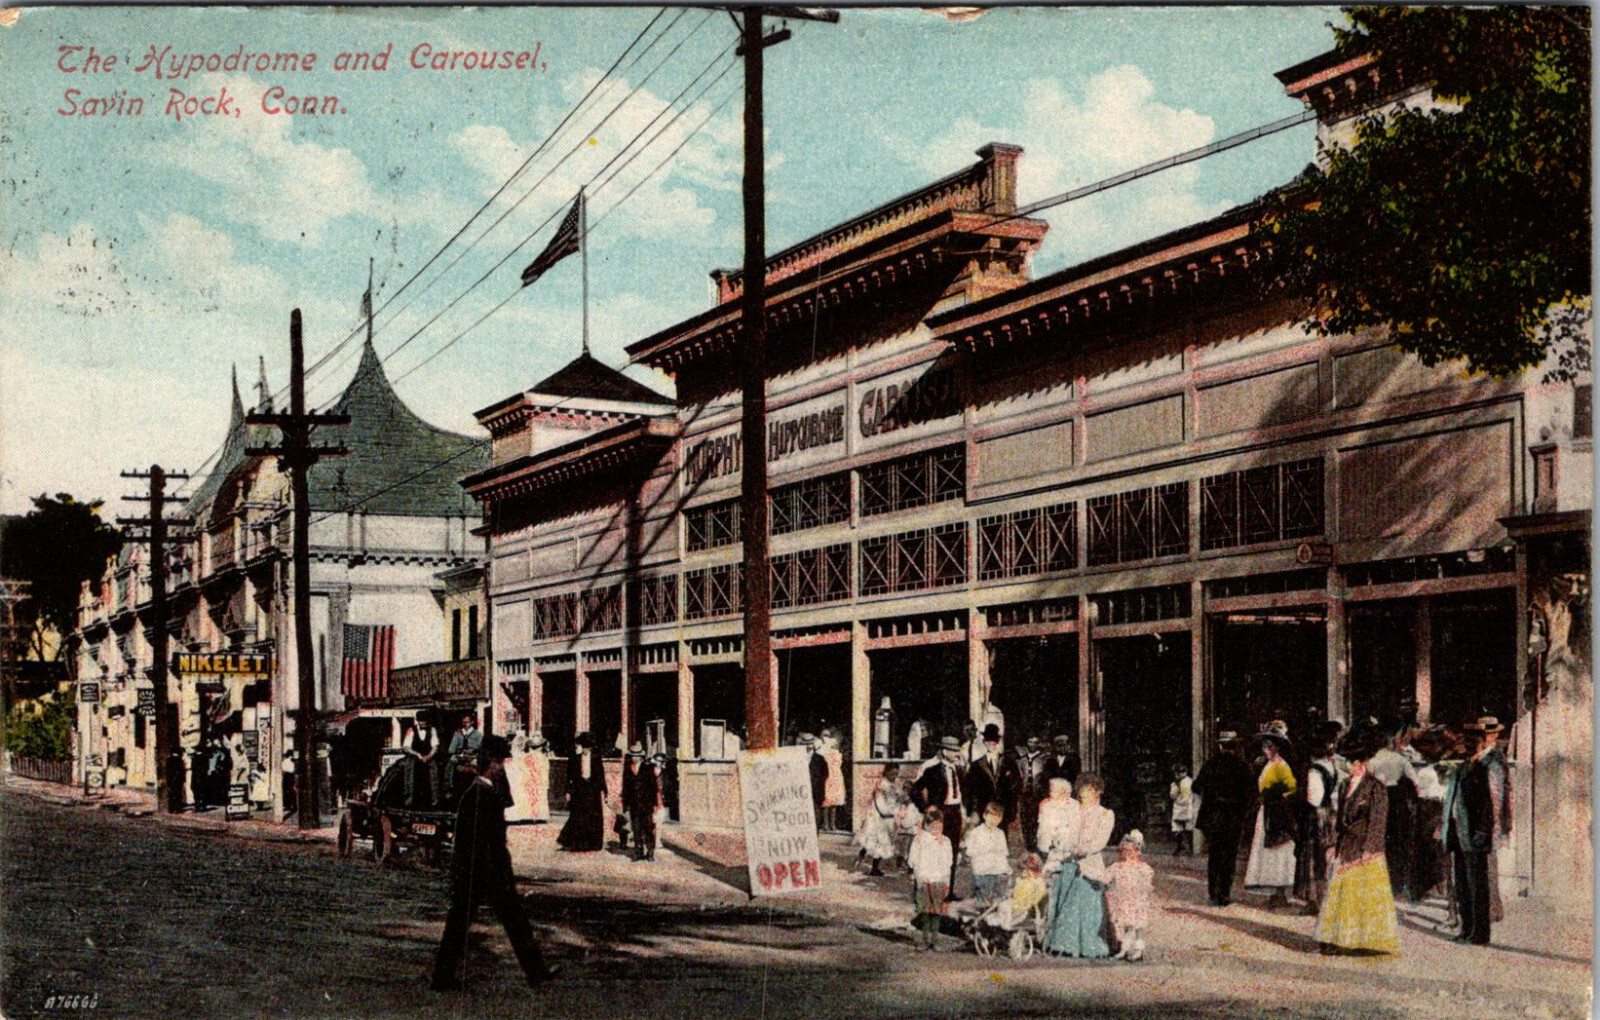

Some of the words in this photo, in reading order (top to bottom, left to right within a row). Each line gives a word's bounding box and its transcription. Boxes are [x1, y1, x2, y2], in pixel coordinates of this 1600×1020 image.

[768, 405, 844, 462] HIPPODROME
[180, 654, 265, 671] NIKELET
[767, 835, 807, 858] NOW
[757, 860, 820, 891] OPEN
